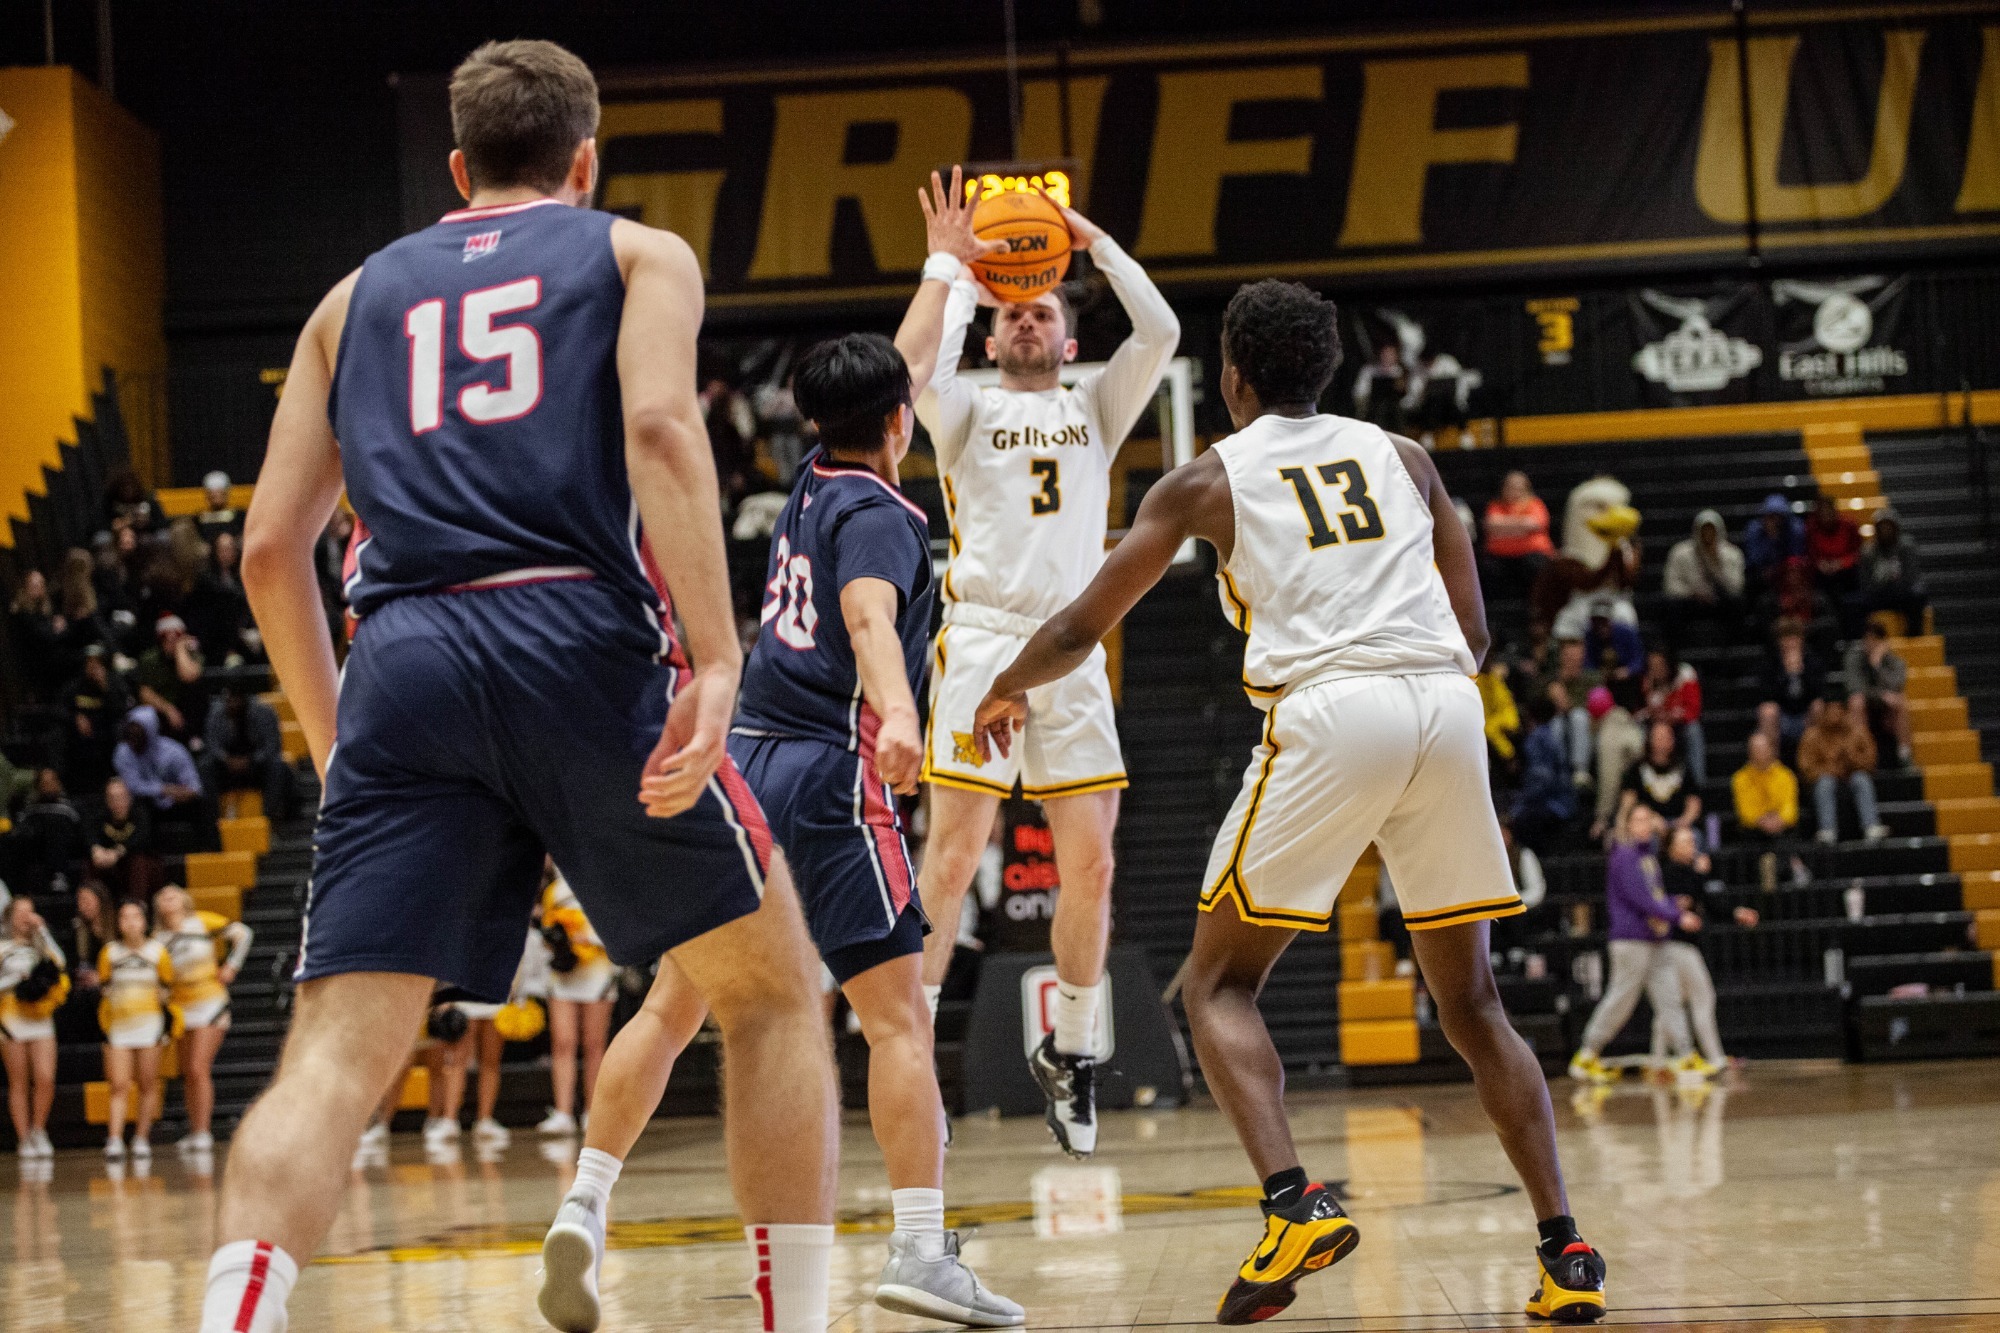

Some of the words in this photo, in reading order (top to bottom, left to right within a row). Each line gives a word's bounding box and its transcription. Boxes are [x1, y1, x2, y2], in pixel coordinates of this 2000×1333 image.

[1694, 26, 2000, 224] U
[986, 266, 1058, 290] Wilson
[1007, 233, 1049, 254] NCA
[404, 274, 544, 437] 15
[1029, 457, 1062, 517] 3
[1277, 457, 1387, 552] 13
